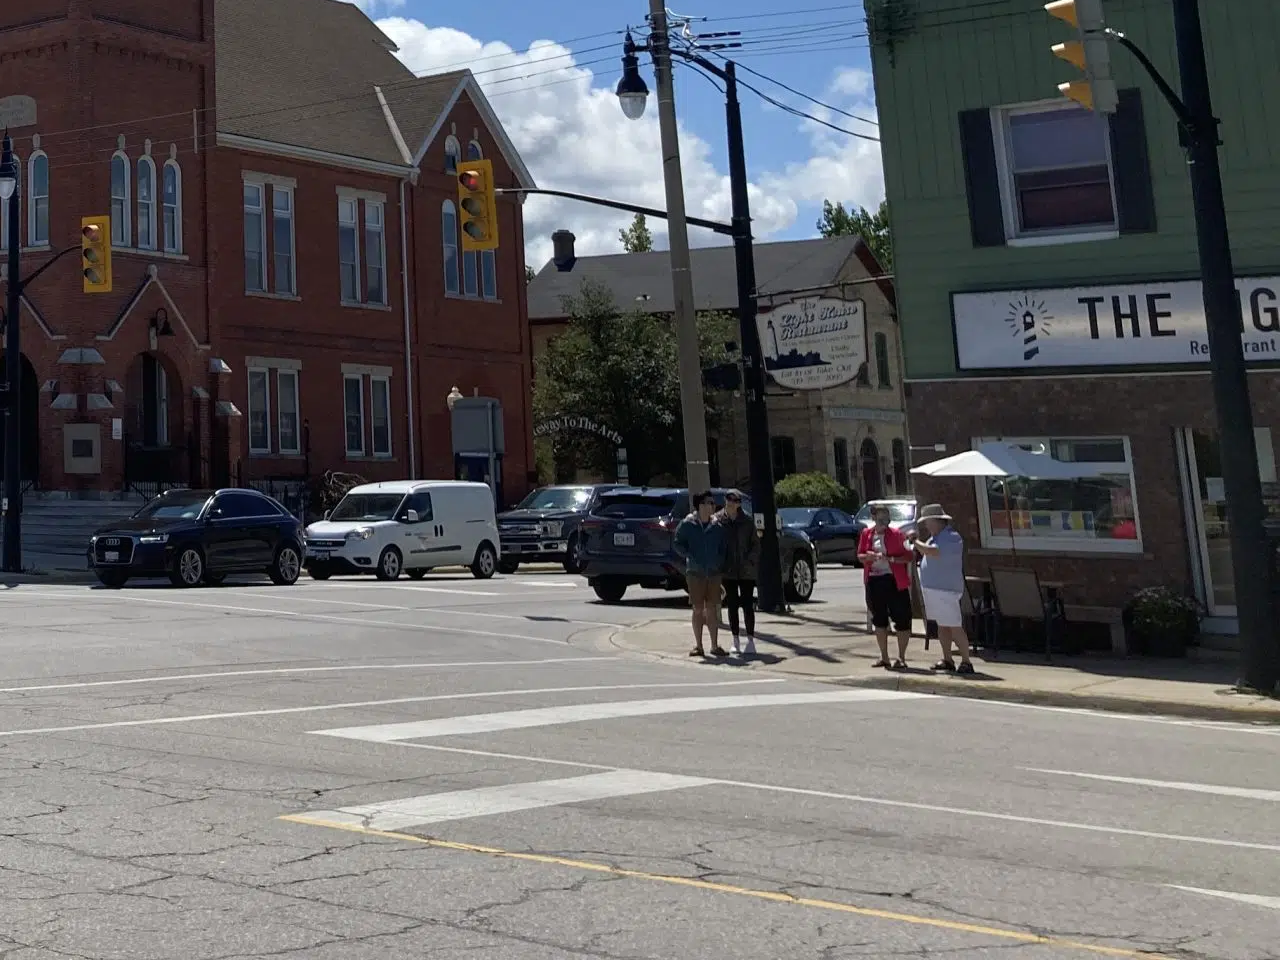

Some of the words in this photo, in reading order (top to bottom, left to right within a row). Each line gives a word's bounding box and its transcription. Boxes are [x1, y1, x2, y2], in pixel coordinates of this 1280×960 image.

[1077, 293, 1177, 339] THE
[1190, 338, 1277, 355] Rerant
[561, 416, 576, 428] To
[577, 416, 598, 431] The
[598, 425, 624, 444] Arts
